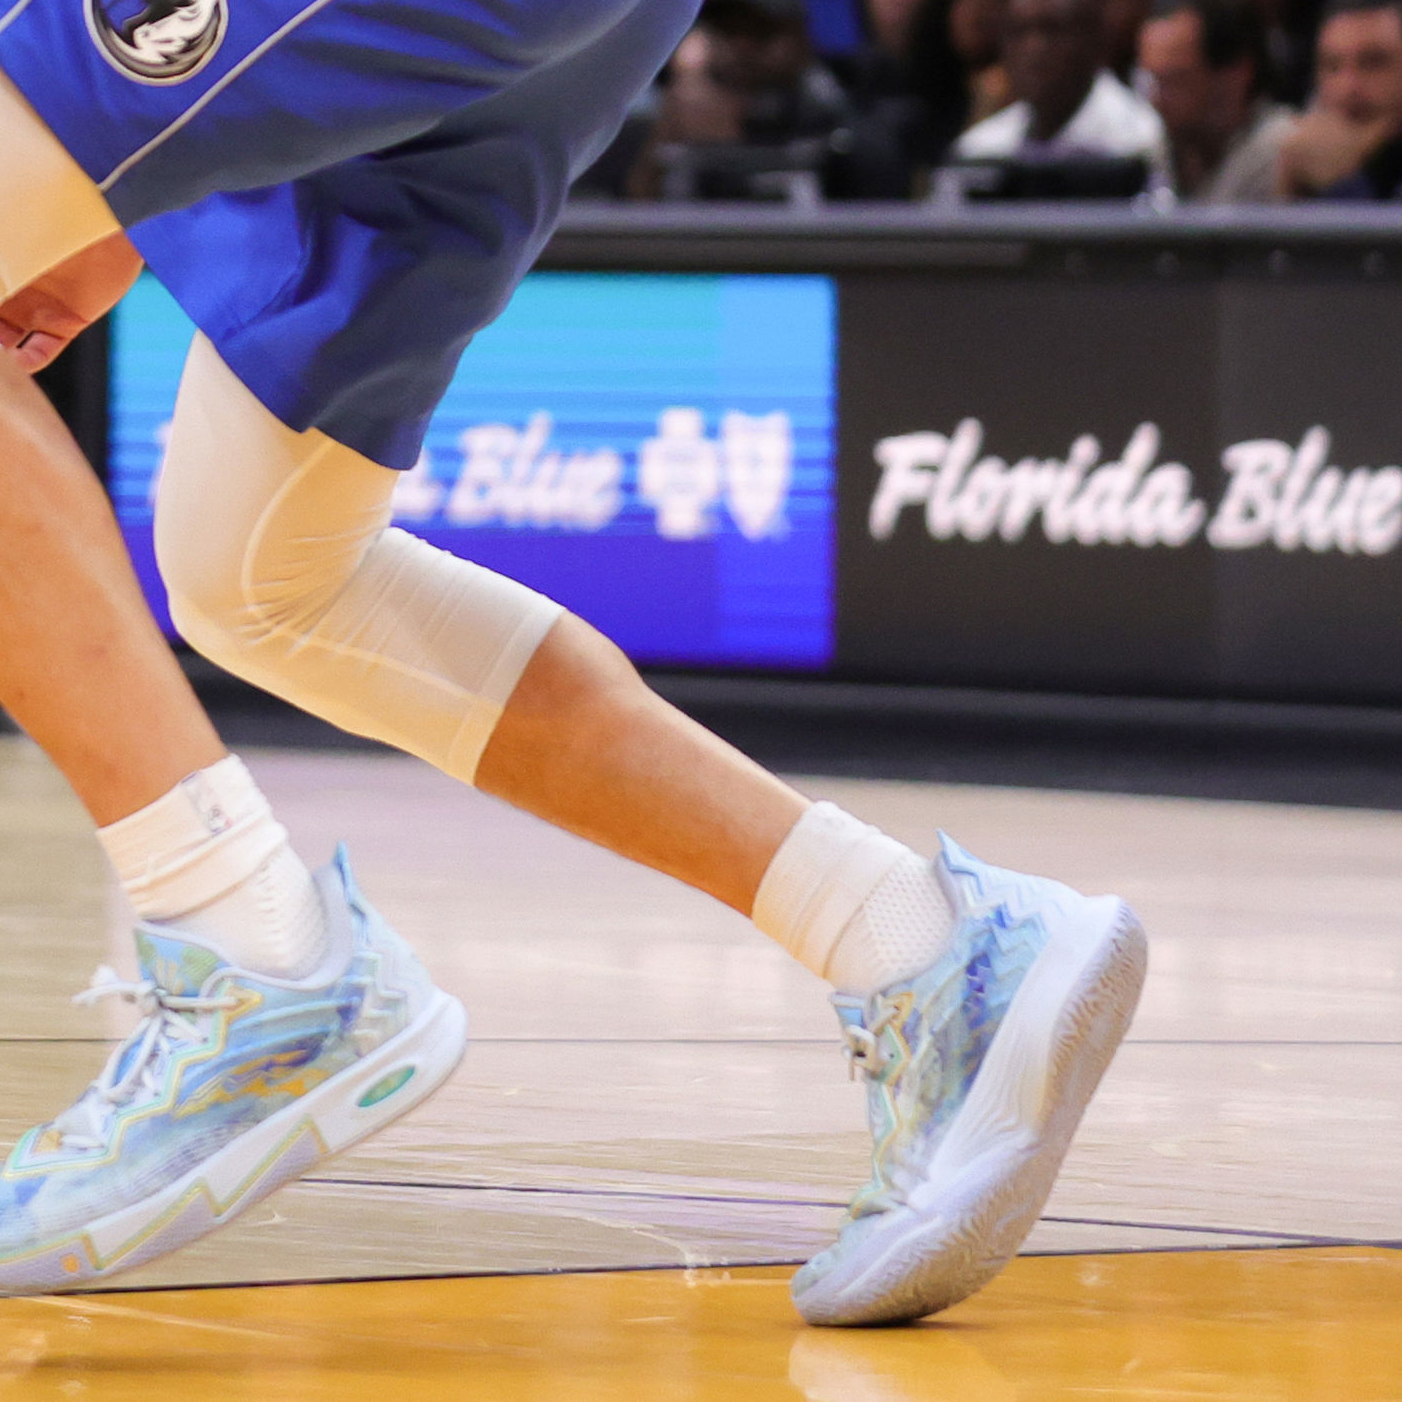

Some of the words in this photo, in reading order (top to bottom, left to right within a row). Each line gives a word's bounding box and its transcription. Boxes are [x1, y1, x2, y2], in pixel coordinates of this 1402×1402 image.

[444, 409, 625, 531] Blue
[868, 416, 1207, 549] Florida
[1205, 424, 1402, 557] Blue
